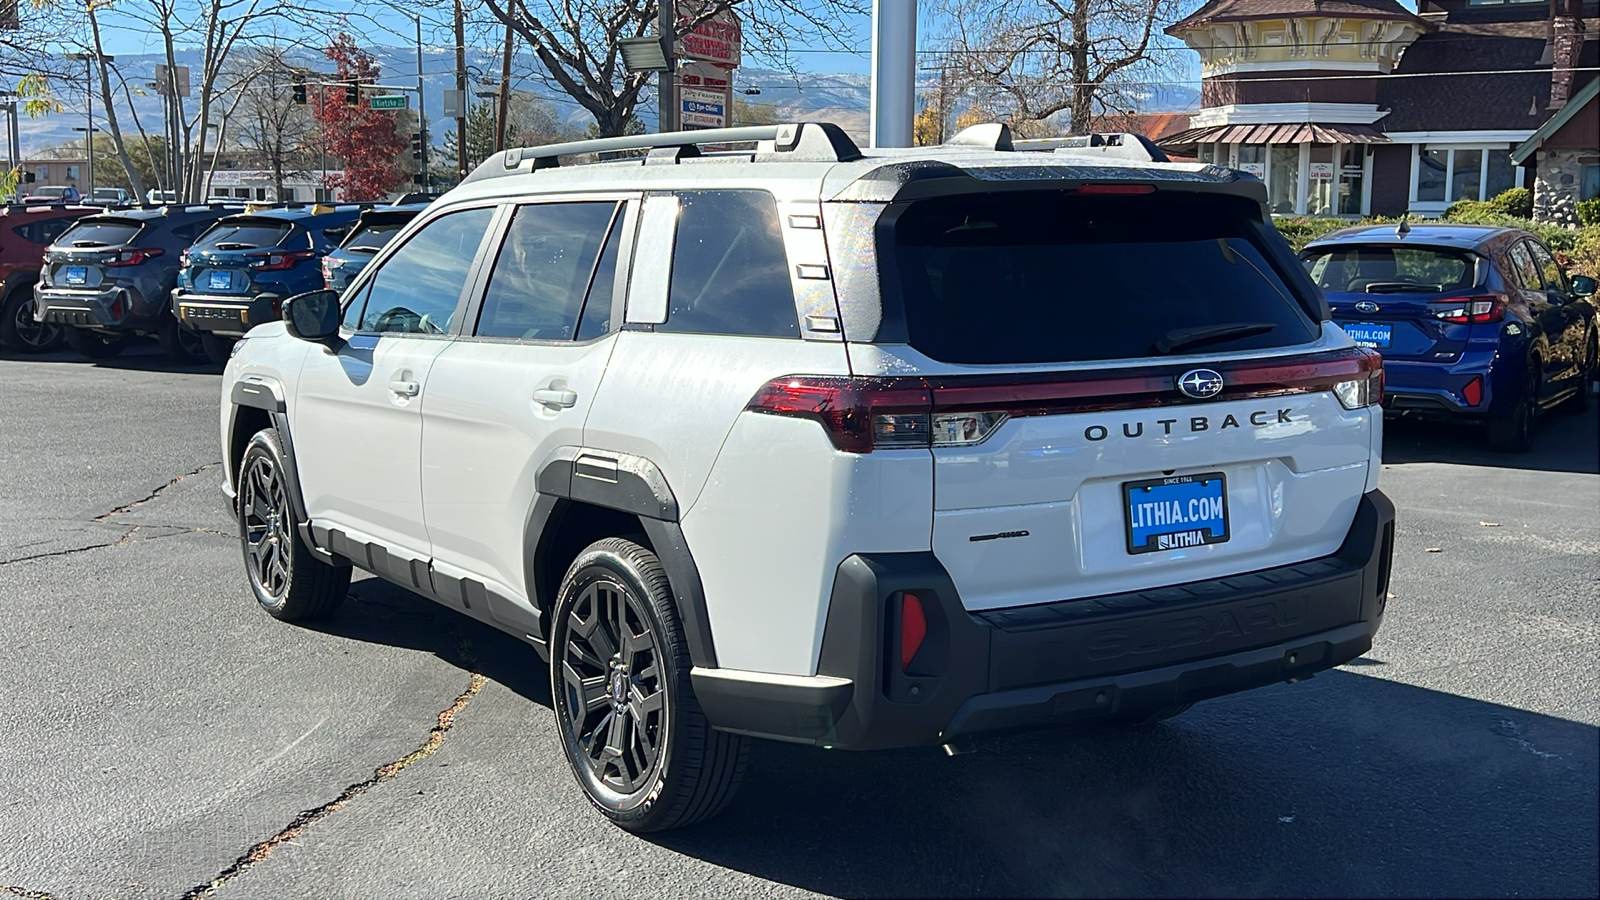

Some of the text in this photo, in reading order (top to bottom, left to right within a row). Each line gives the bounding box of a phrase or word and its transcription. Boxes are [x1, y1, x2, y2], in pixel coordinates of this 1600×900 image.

[376, 98, 397, 107] Kietzke
[1084, 408, 1293, 441] OUTBACK
[1130, 495, 1224, 528] LITHIA.COM
[1168, 530, 1205, 548] LITHIA
[1088, 596, 1308, 661] SUBARU
